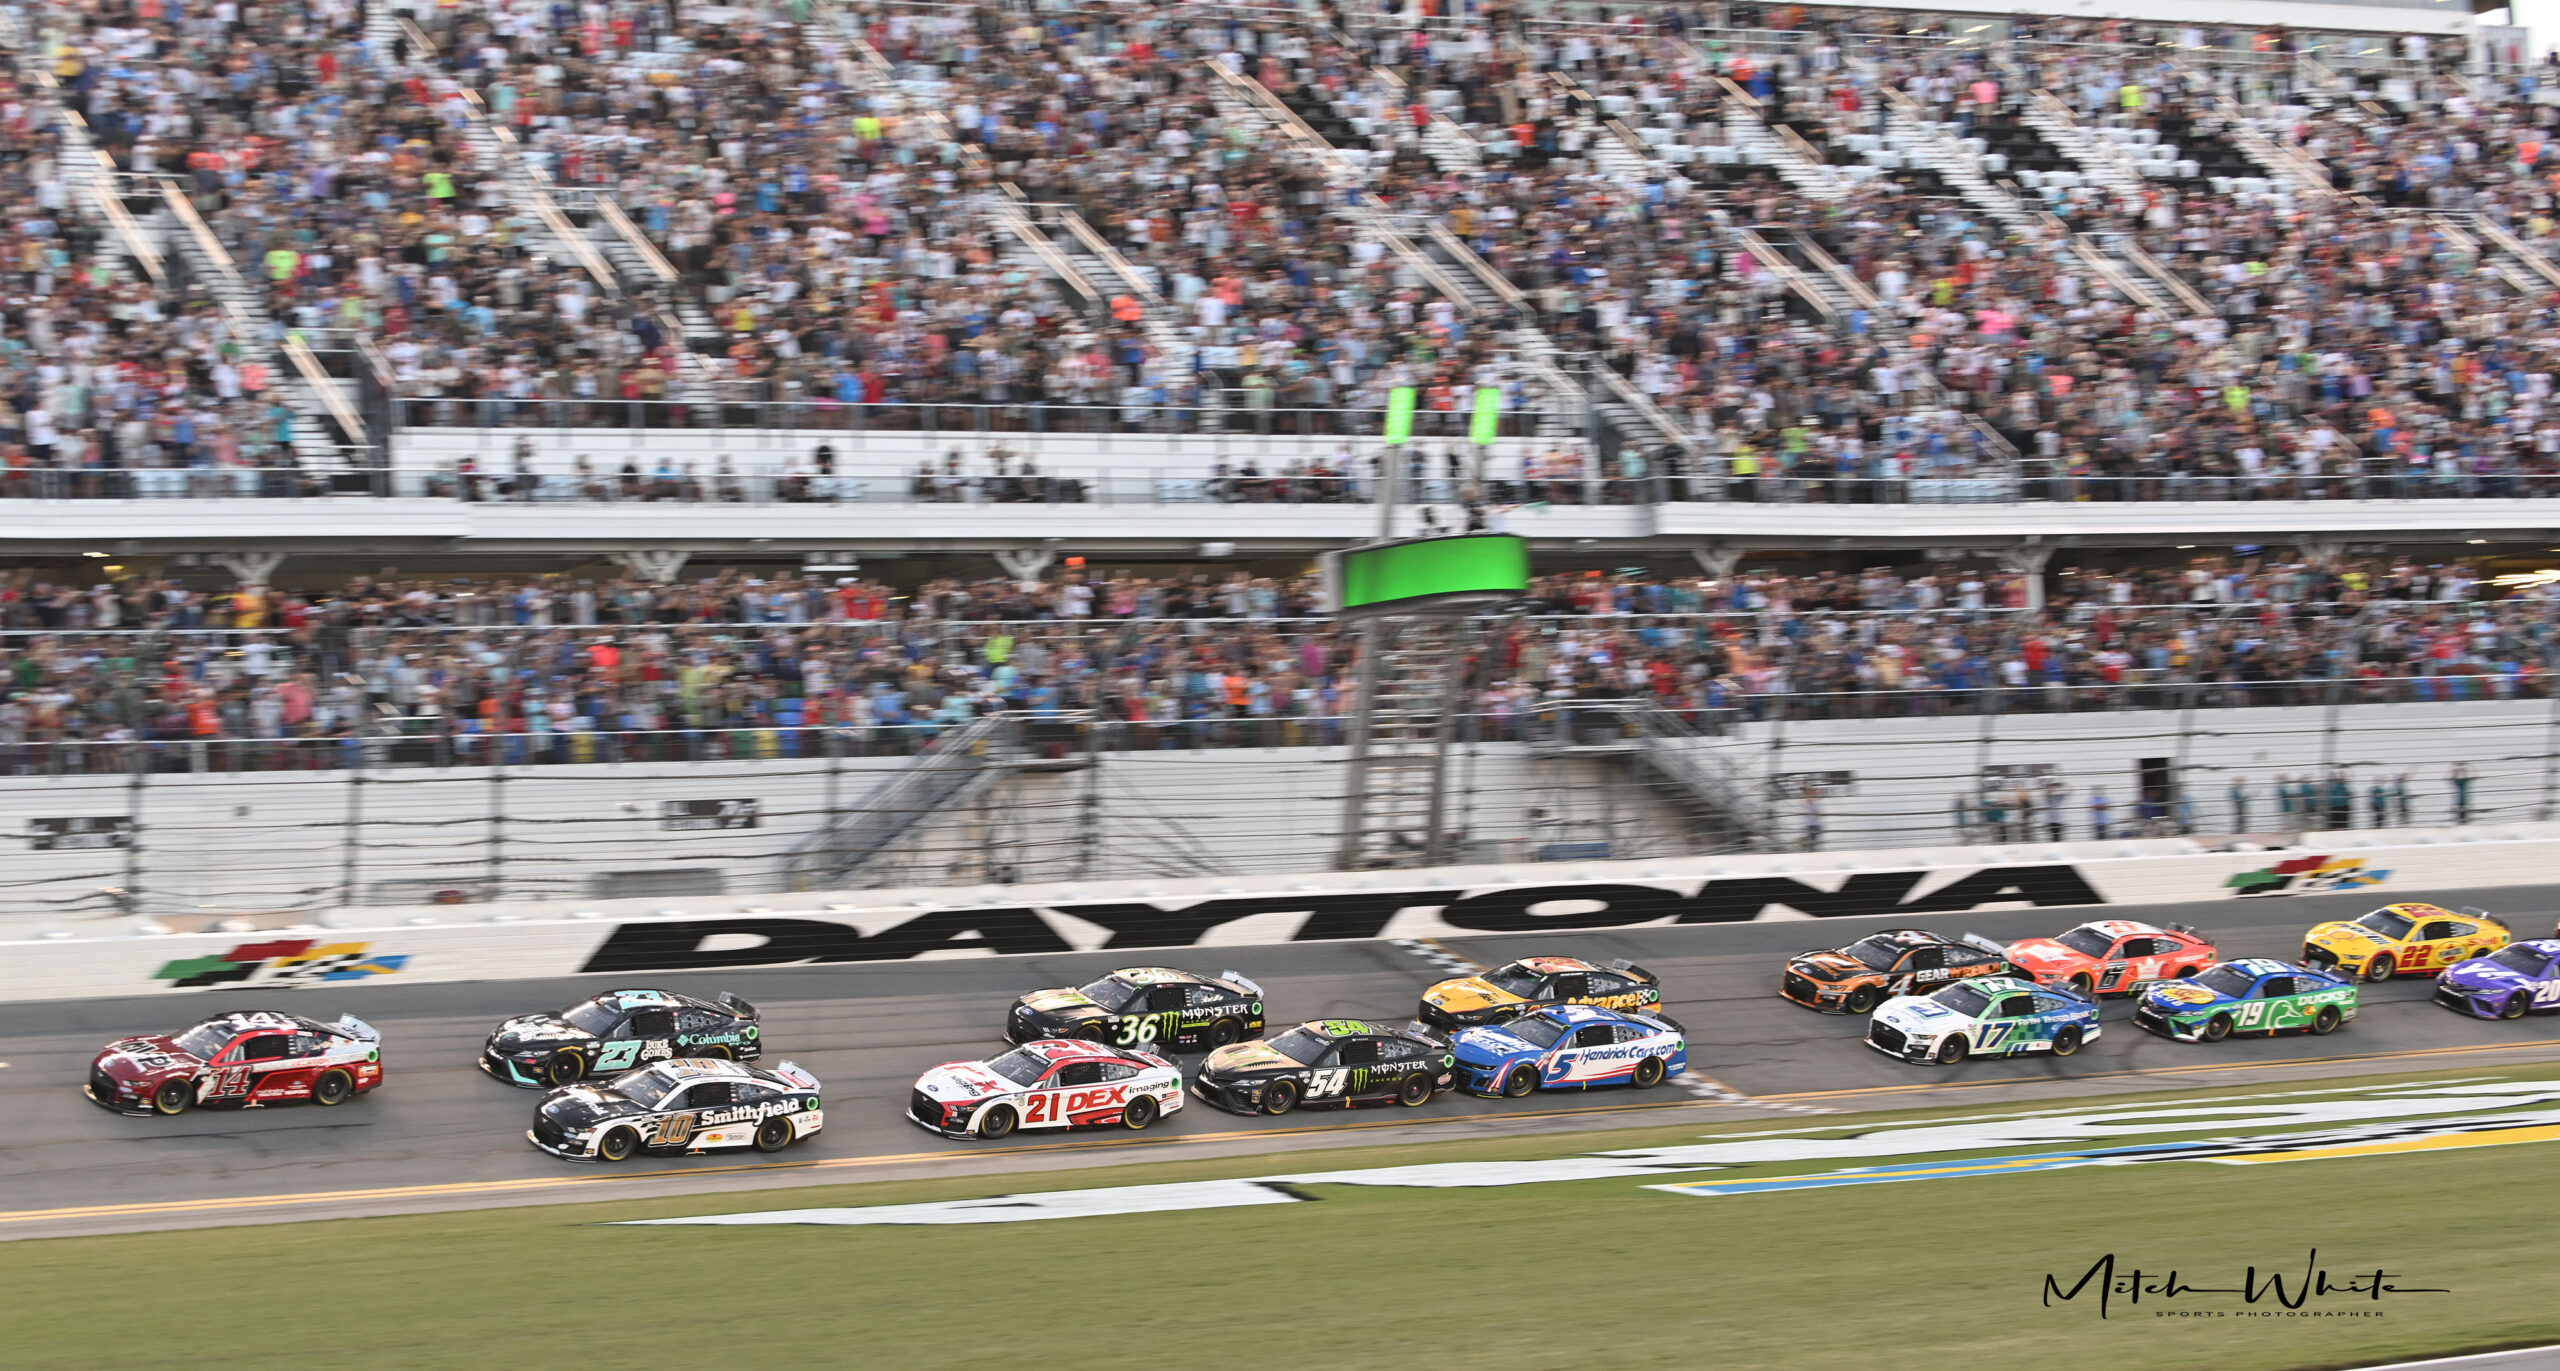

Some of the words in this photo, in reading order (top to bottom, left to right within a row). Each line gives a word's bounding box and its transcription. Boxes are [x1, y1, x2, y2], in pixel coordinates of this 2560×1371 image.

[580, 864, 2108, 974] DAYTONA
[2400, 945, 2433, 967] 22
[2297, 991, 2347, 1006] DUCKS
[2535, 979, 2560, 1002] 20
[1181, 1003, 1249, 1020] MONSTER
[2238, 1002, 2266, 1026] 19
[689, 1032, 741, 1046] Columbia
[1116, 1013, 1160, 1045] 36
[1322, 1020, 1373, 1037] 54
[1974, 1021, 2016, 1049] 17
[592, 1040, 643, 1072] 23
[641, 1047, 673, 1061] COMBS
[646, 1039, 669, 1050] LUKE
[1030, 1054, 1049, 1065] BURTON
[1371, 1060, 1428, 1075] MONSTER
[1546, 1053, 1581, 1083] 5
[207, 1067, 252, 1098] 14
[1303, 1067, 1351, 1099] 54
[1025, 1093, 1061, 1124] 21
[1066, 1085, 1129, 1112] DEX
[1129, 1081, 1170, 1094] imaging
[702, 1098, 800, 1126] Smithfield
[648, 1112, 697, 1148] 10
